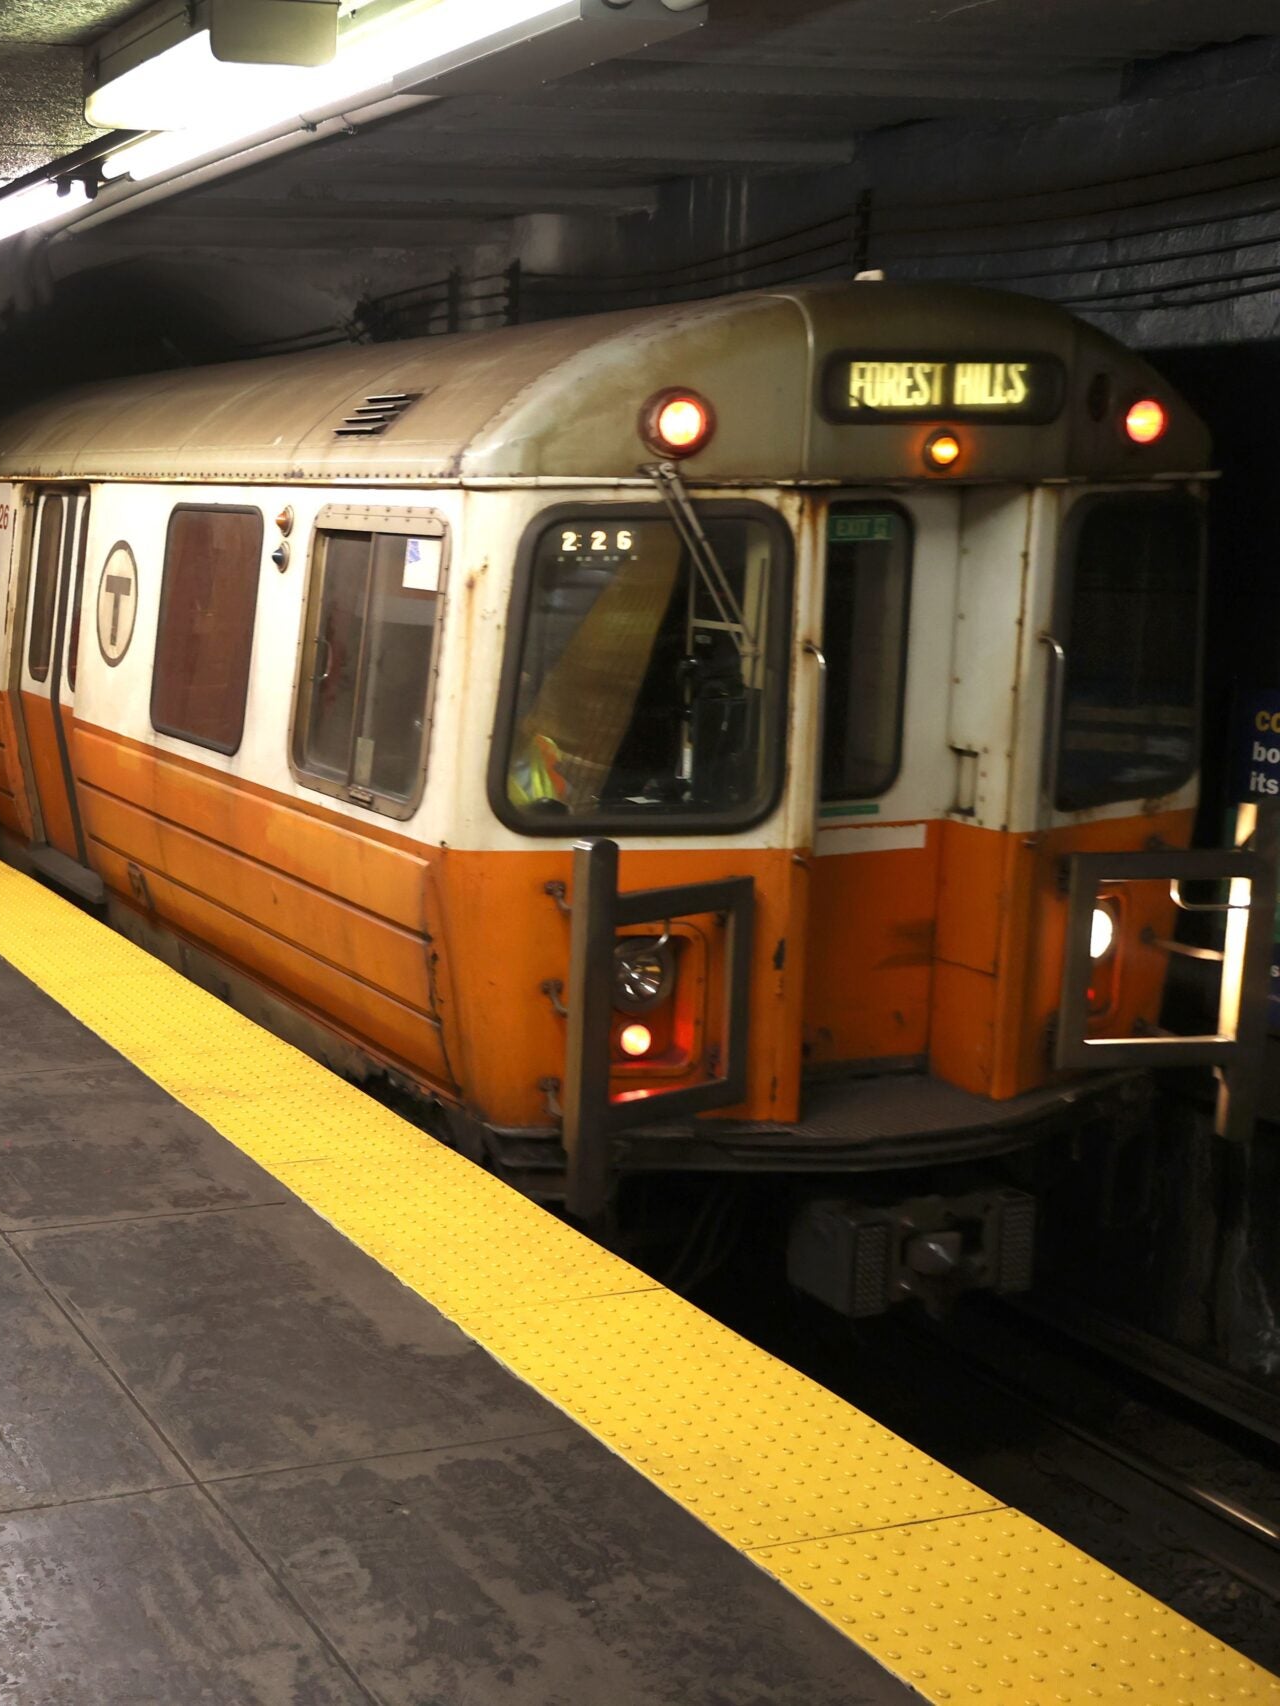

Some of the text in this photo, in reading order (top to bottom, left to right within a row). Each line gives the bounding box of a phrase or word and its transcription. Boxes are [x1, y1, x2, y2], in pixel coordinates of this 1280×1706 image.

[849, 361, 1027, 407] FOREST HILLS
[105, 574, 132, 646] T
[1249, 771, 1279, 795] its
